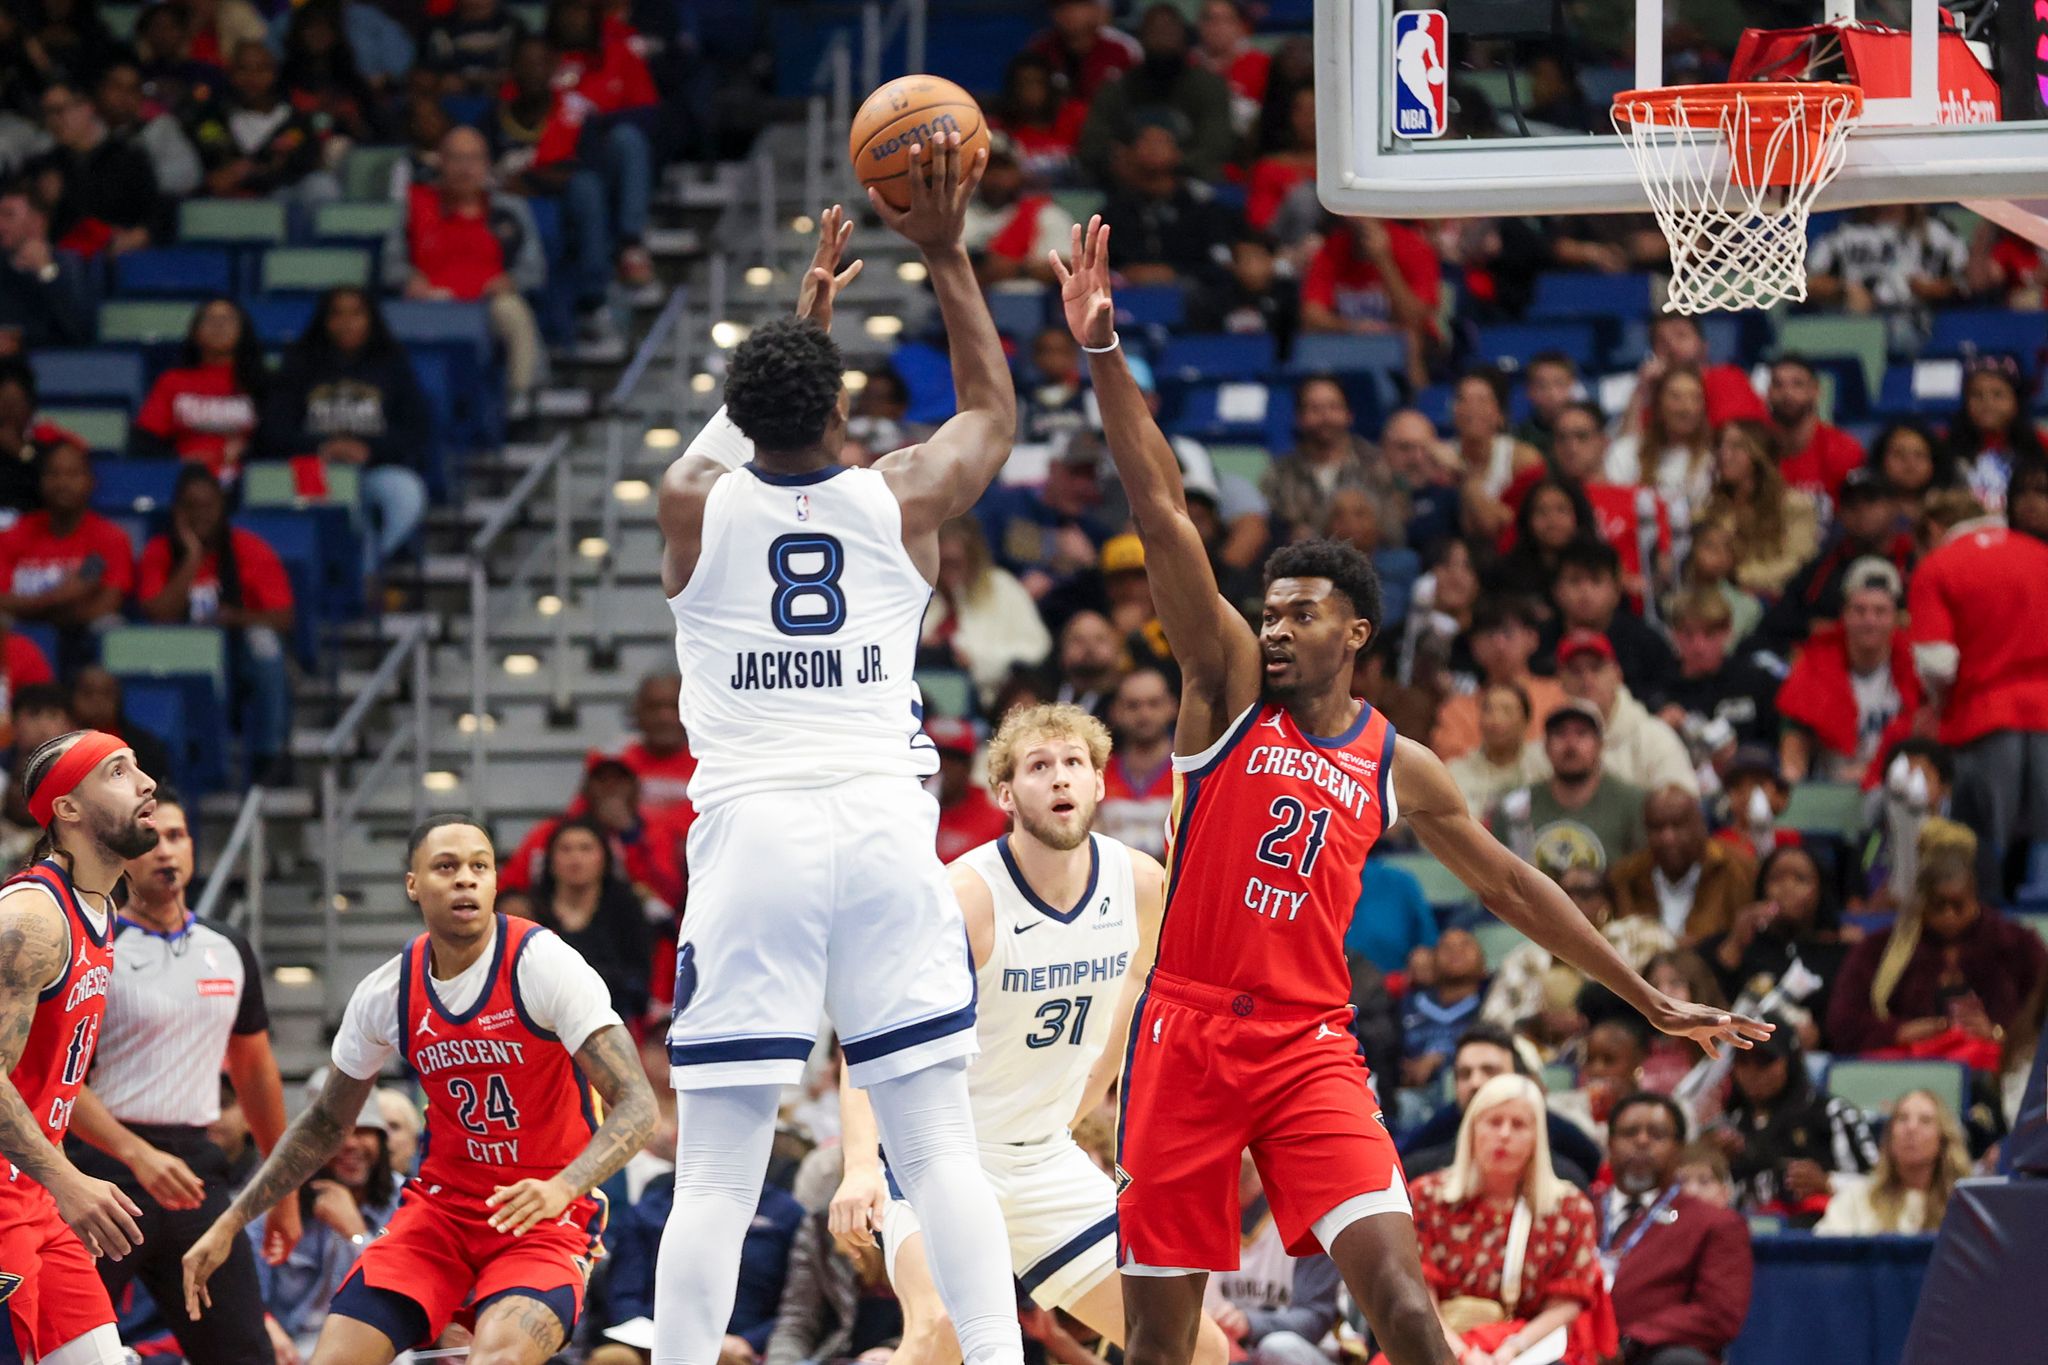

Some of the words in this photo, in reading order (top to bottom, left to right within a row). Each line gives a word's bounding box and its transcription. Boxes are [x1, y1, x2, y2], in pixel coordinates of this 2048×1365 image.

[870, 113, 961, 161] Wilson
[1401, 108, 1427, 130] NBA
[768, 533, 847, 636] 8
[731, 649, 843, 690] JACKSON
[857, 644, 888, 684] JR.
[1246, 745, 1370, 820] CRESCENT
[1337, 750, 1378, 771] NEWAGE
[1339, 761, 1372, 777] PRODUCTS
[1256, 795, 1332, 878] 21
[1244, 876, 1309, 921] CITY
[1002, 951, 1129, 993] MEMPHIS
[478, 1008, 517, 1026] NEWAGE
[1026, 995, 1093, 1050] 31
[416, 1039, 525, 1076] CRESCENT
[447, 1074, 521, 1136] 24
[466, 1138, 519, 1165] CITY
